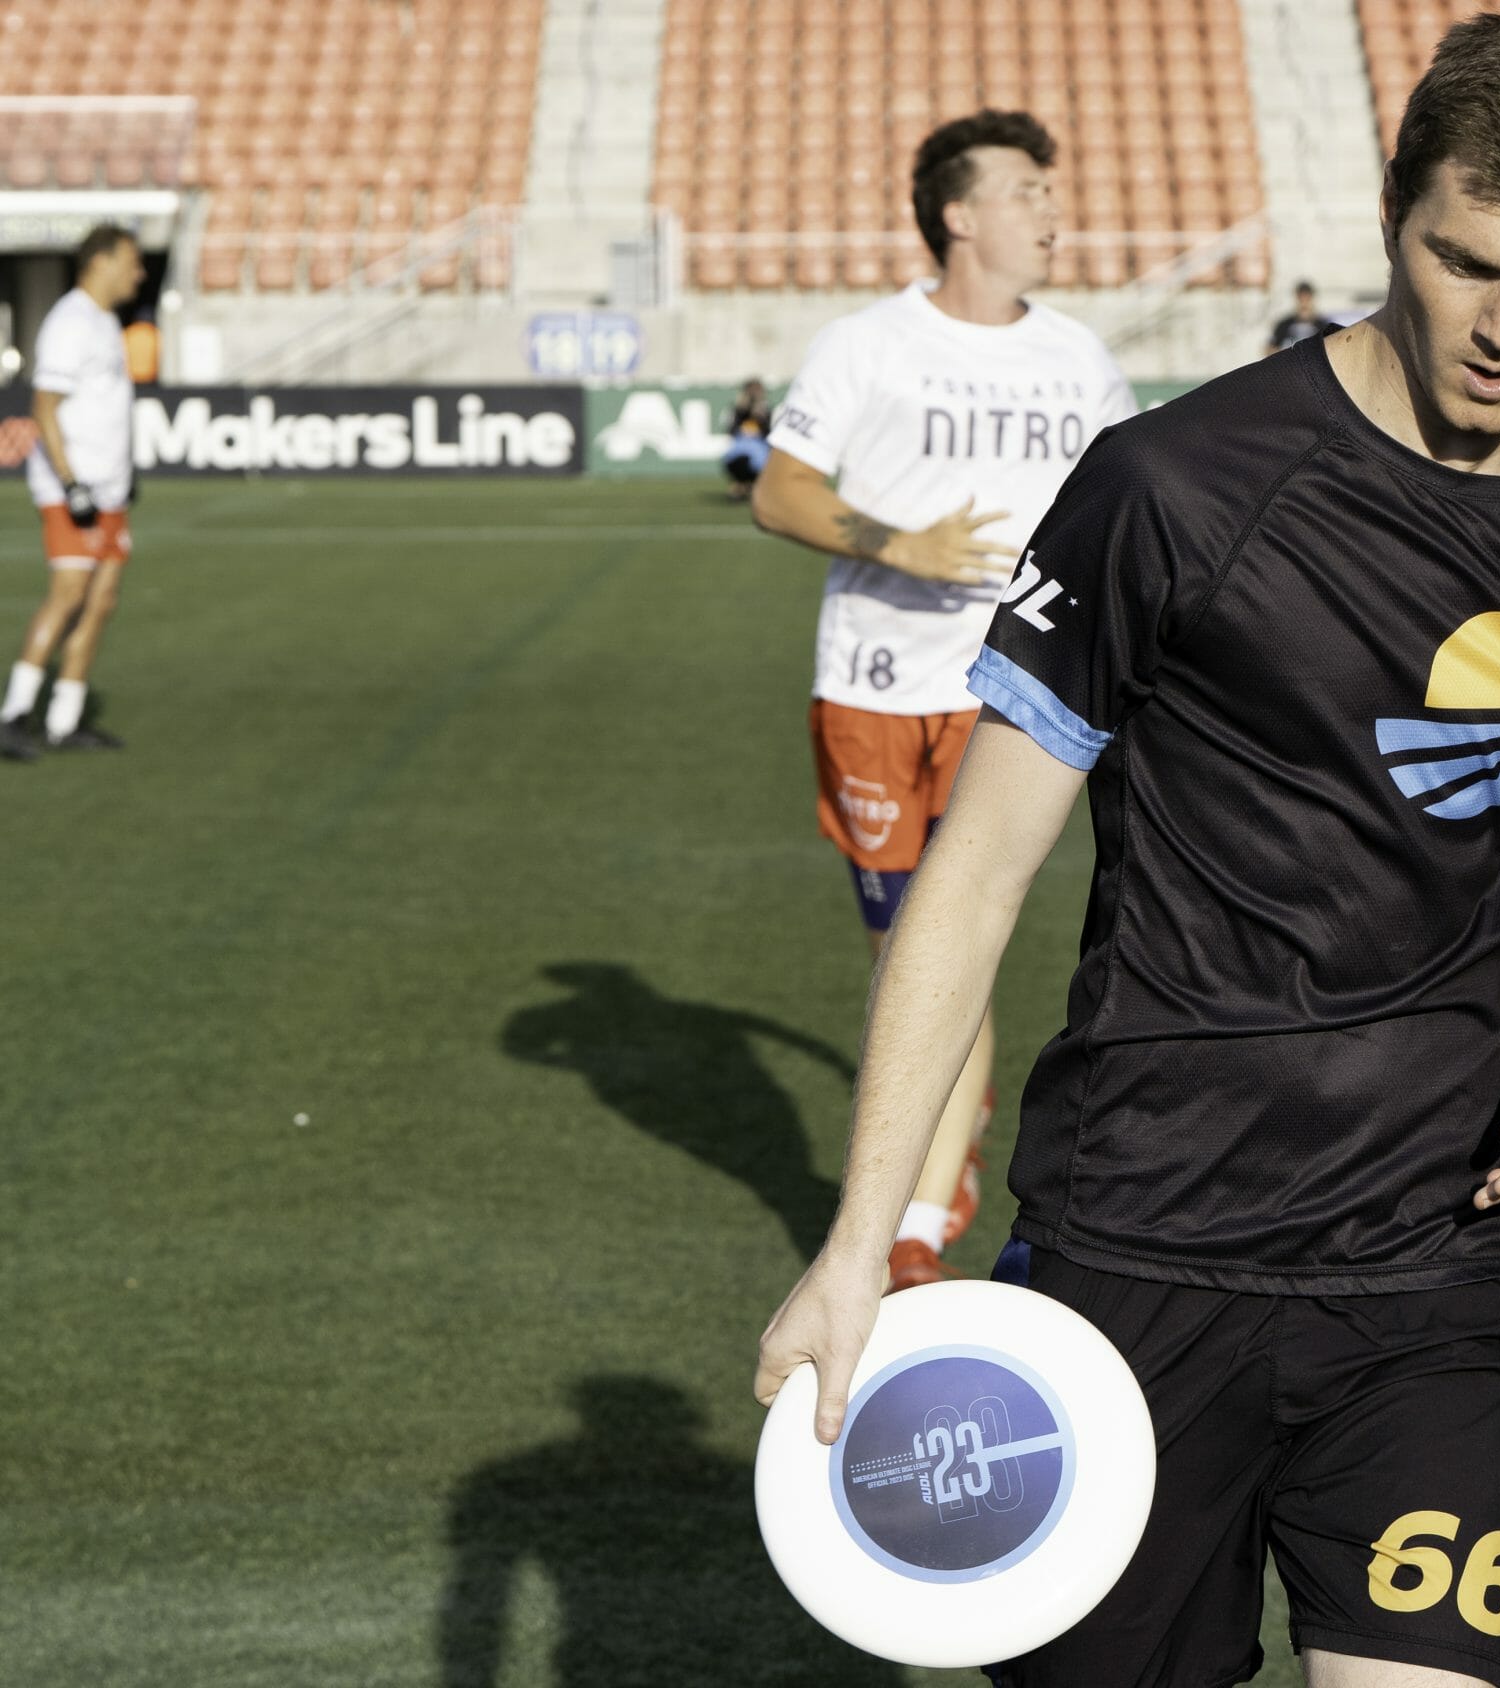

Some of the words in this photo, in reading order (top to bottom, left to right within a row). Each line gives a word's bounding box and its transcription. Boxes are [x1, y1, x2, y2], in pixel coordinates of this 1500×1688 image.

[923, 407, 1085, 460] NITRO
[848, 641, 896, 691] 18
[919, 1472, 934, 1505] AUDL
